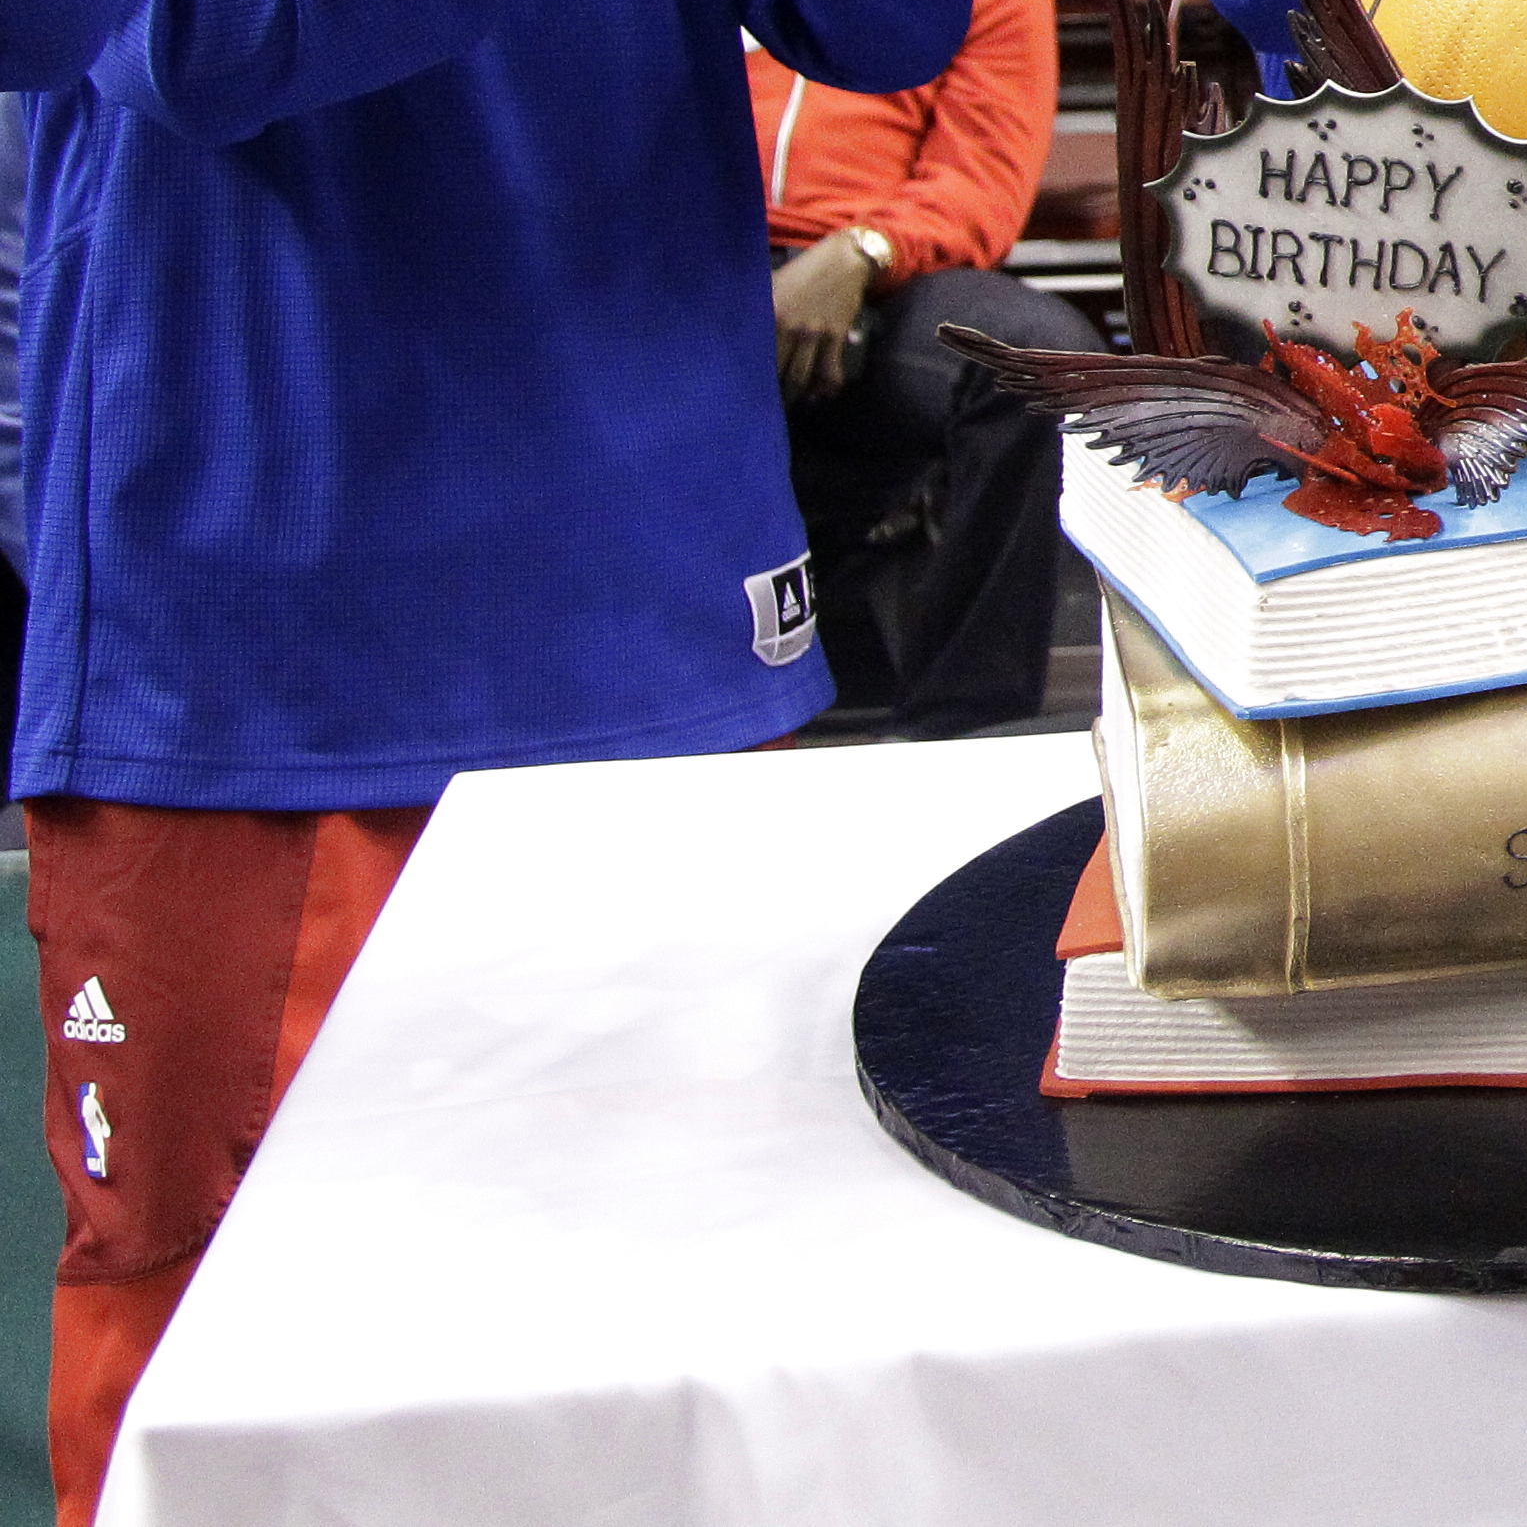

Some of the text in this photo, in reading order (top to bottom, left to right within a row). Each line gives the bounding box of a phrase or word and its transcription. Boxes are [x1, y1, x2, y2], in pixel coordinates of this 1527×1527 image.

[1259, 148, 1465, 221] HAPPY
[1208, 218, 1507, 304] BIRTHDAY
[63, 1018, 127, 1044] adidas
